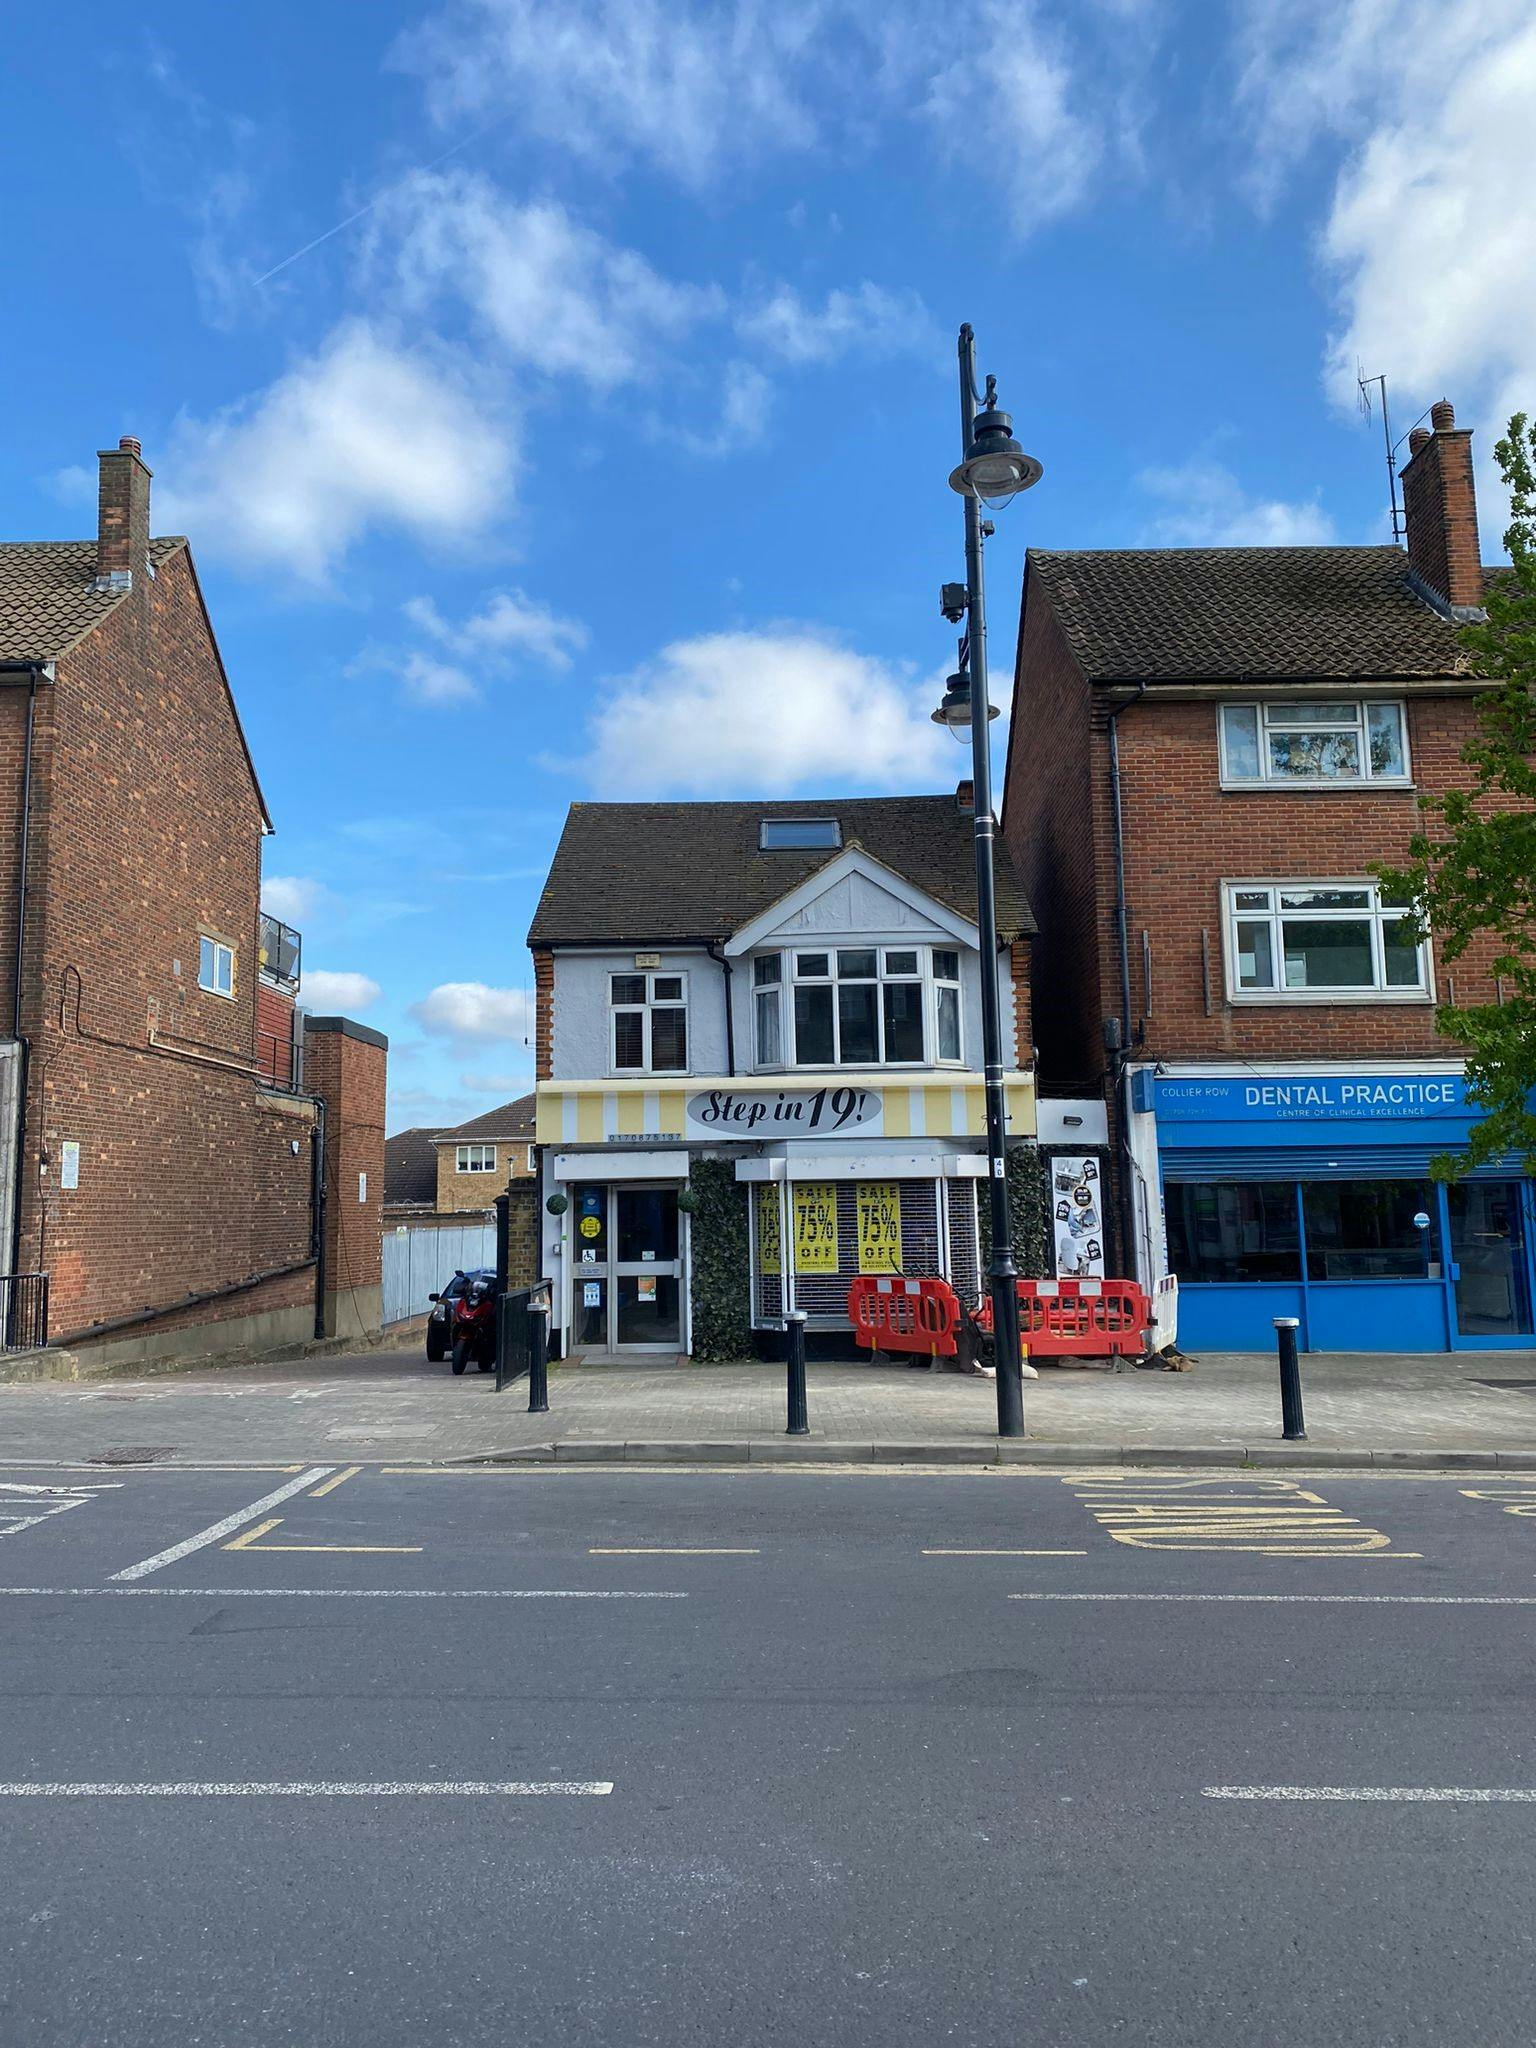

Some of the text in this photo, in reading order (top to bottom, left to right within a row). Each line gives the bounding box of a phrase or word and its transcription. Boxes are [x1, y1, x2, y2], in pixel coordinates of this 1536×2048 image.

[1162, 1087, 1230, 1097] COLLIER ROW
[1245, 1084, 1456, 1106] DENTAL PRACTICE
[701, 1087, 867, 1130] Step in 19!
[1276, 1107, 1425, 1117] CENTRE OF CLINICAL EXCELLENCE
[796, 1187, 834, 1199] SALE
[860, 1187, 897, 1199] SALE
[798, 1204, 834, 1243] 75%
[861, 1203, 898, 1242] 75%
[801, 1246, 831, 1259] OFF
[865, 1246, 896, 1259] OFF
